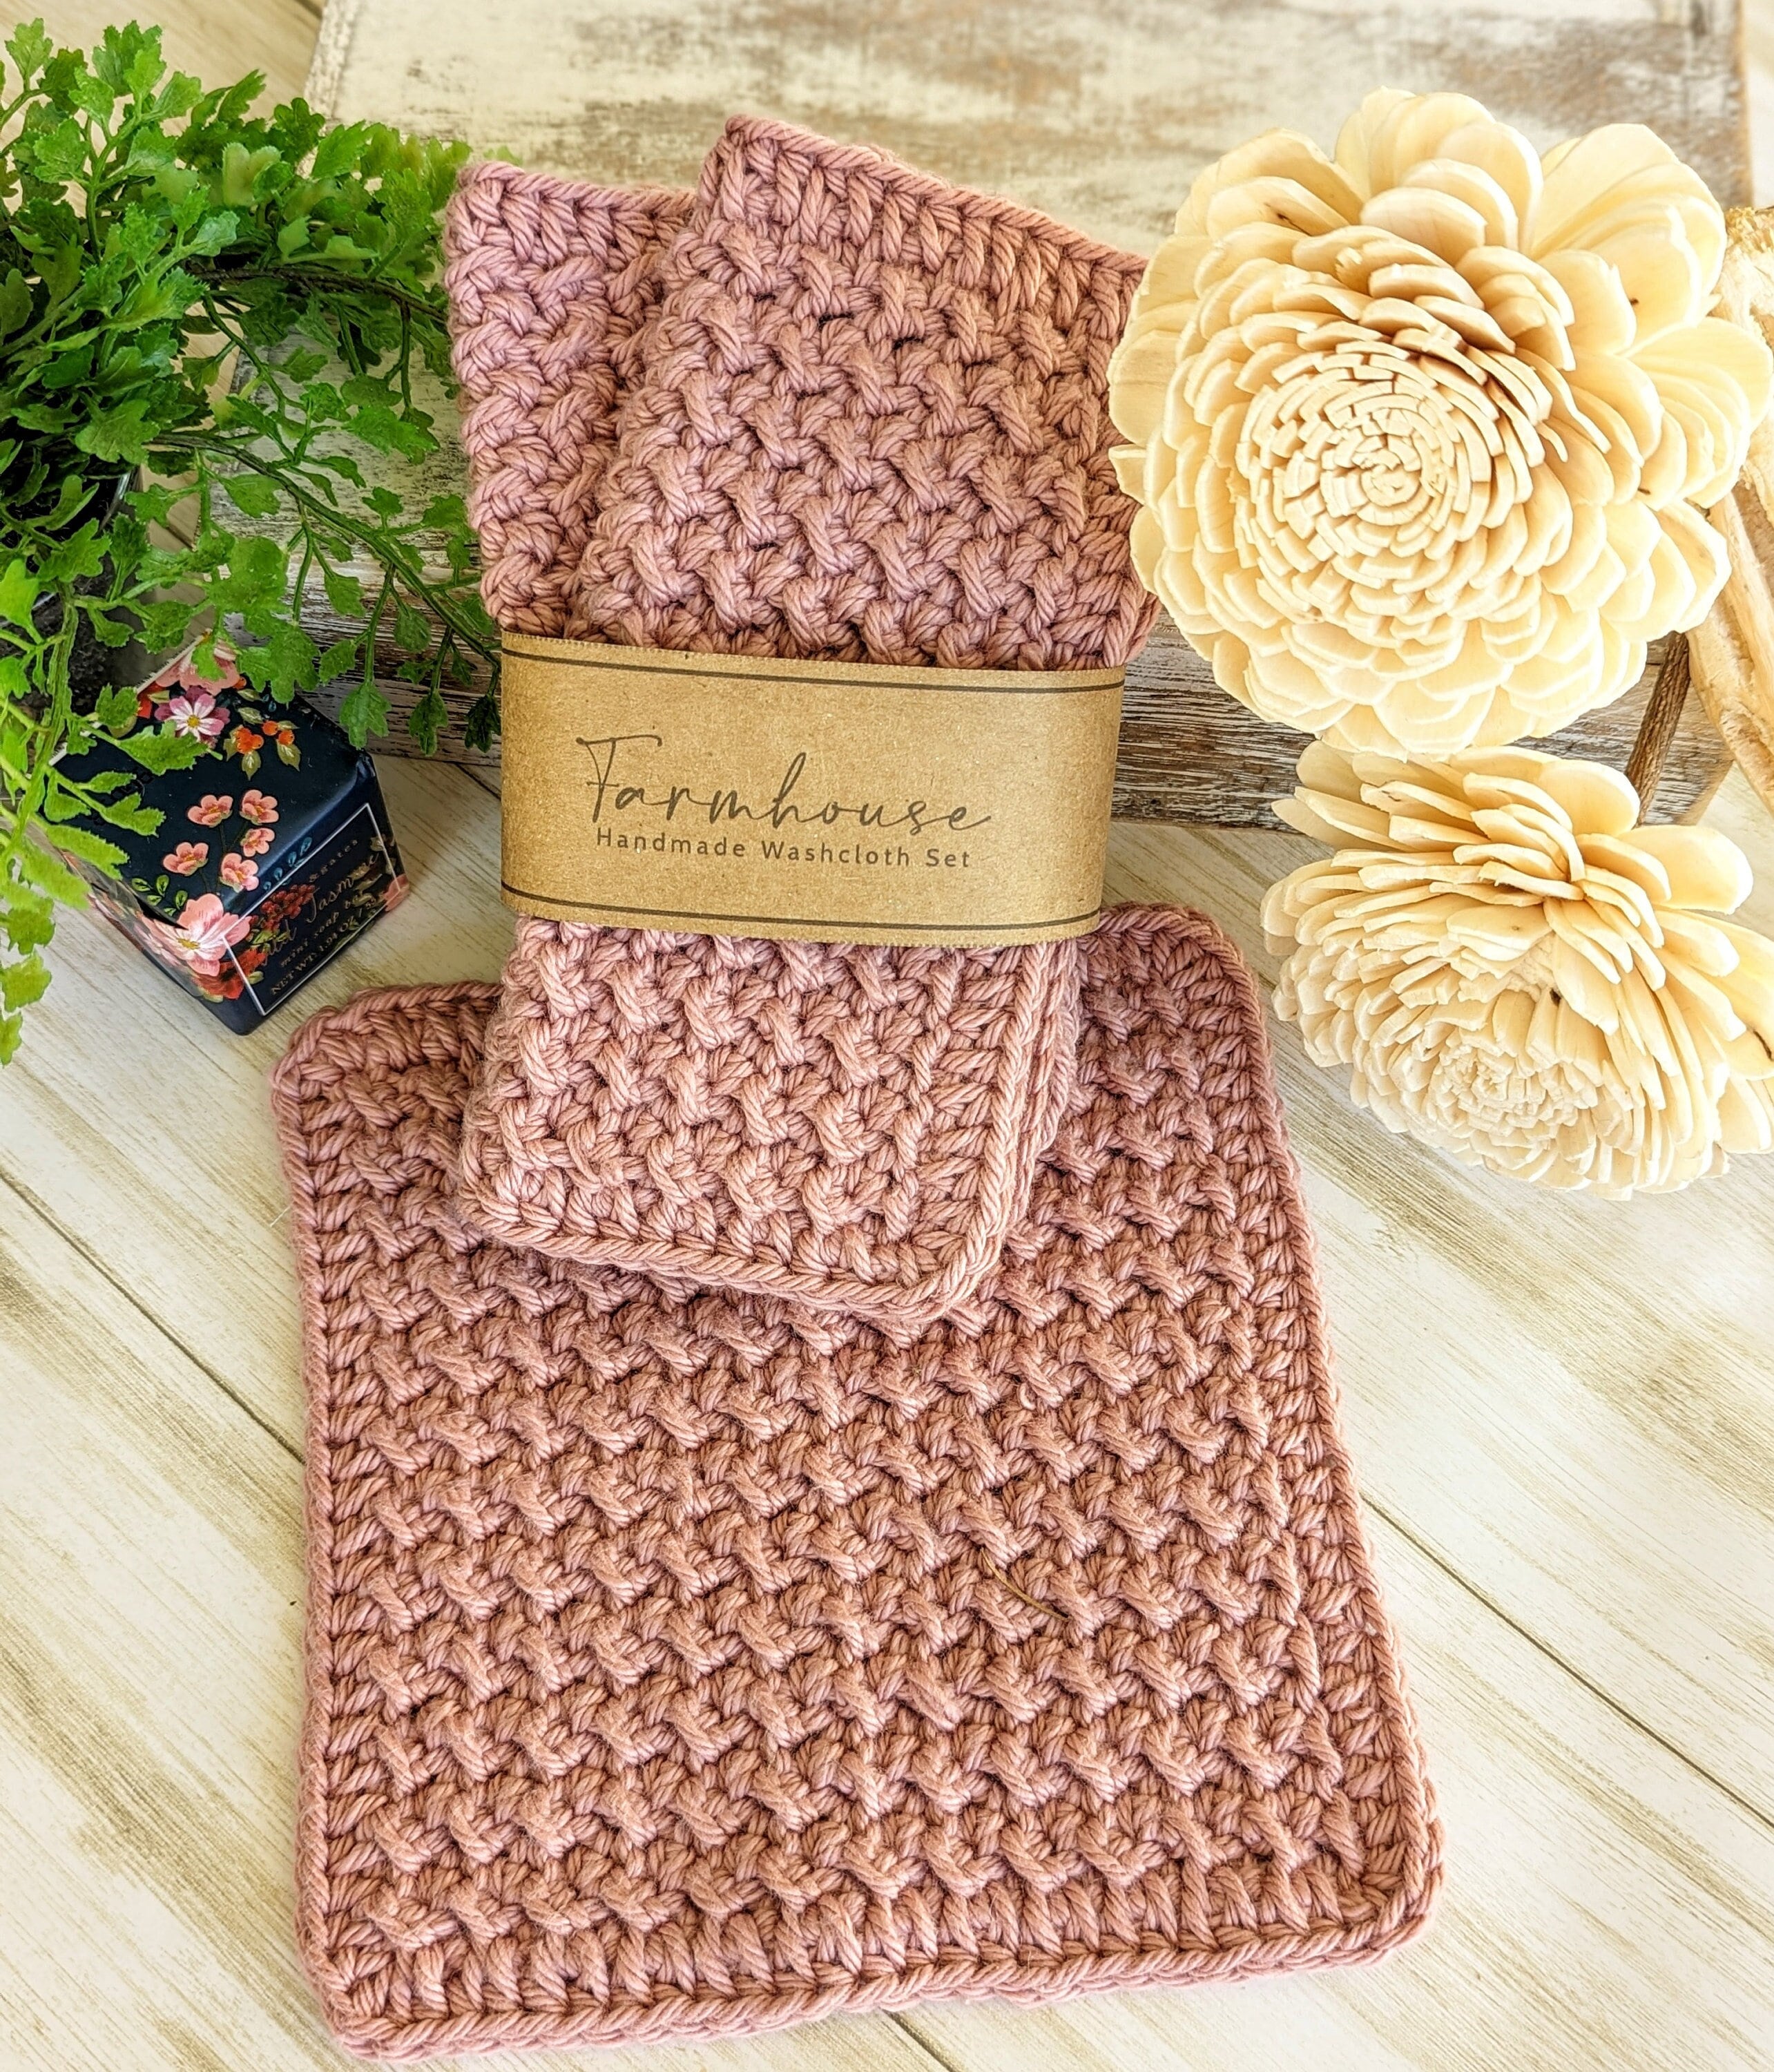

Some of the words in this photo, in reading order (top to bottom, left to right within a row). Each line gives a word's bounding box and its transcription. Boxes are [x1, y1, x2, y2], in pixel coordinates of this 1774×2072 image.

[576, 734, 992, 836] Farmhouse
[597, 827, 746, 858] Handmade
[762, 840, 910, 867] Washcloth
[925, 848, 972, 868] Set
[305, 852, 380, 923] Jasme
[280, 938, 308, 967] mini
[314, 912, 339, 939] soap
[271, 970, 295, 995] NET
